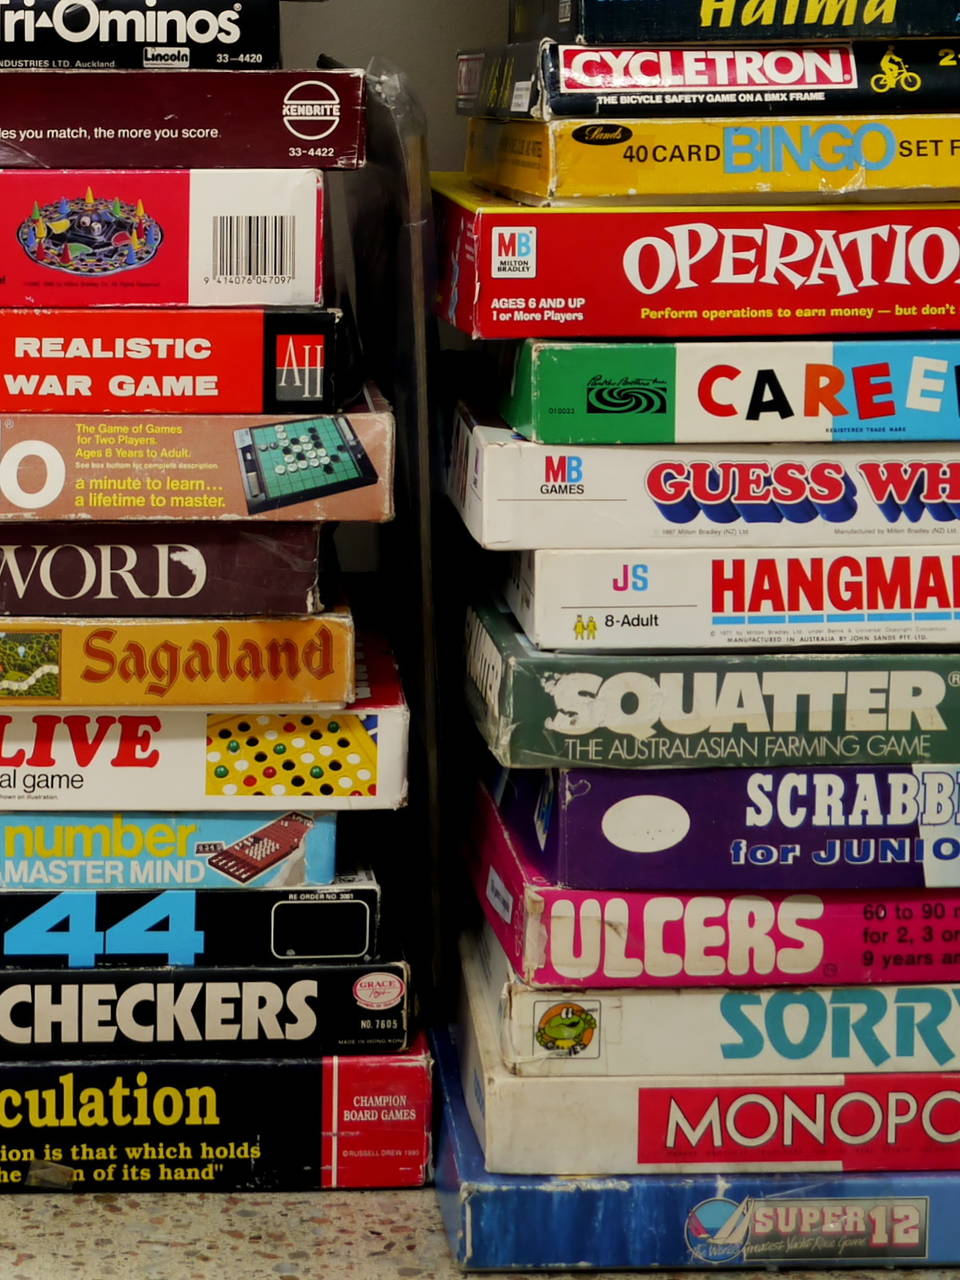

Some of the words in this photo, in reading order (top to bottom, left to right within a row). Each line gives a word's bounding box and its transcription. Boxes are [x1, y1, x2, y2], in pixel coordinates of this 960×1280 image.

[143, 48, 189, 65] Lincoln
[282, 104, 340, 117] KENBRITE
[620, 95, 663, 105] BICYCLE
[764, 93, 787, 102] BMX
[46, 127, 91, 140] match,
[653, 144, 721, 162] CARD
[722, 122, 896, 174] BINGO
[898, 140, 943, 157] SET
[498, 232, 532, 257] MB
[622, 223, 960, 295] OPERATIO
[491, 298, 526, 309] AGES
[640, 307, 698, 320] Perform
[702, 307, 774, 320] operations
[543, 311, 584, 322] Players
[14, 337, 212, 360] REALISTIC
[3, 374, 92, 396] WAR
[108, 375, 219, 397] GAME
[697, 356, 960, 422] CAREE
[94, 424, 130, 434] Game
[545, 455, 583, 484] MB
[540, 484, 585, 496] GAMES
[645, 460, 851, 514] GUESS
[89, 494, 145, 507] lifetime
[169, 495, 225, 507] master.
[612, 563, 649, 592] JS
[712, 554, 960, 613] HANGMA
[604, 613, 659, 628] 8-Adult
[80, 627, 335, 697] Sagaland
[543, 670, 948, 739] SQUATTER
[608, 736, 759, 760] AUSTRALASIAN
[764, 735, 859, 758] FARMING
[867, 734, 931, 757] GAME
[22, 772, 84, 794] game
[746, 772, 960, 828] SCRABB
[4, 813, 197, 858] number
[731, 838, 800, 866] for
[4, 860, 128, 883] MASTER
[130, 860, 206, 883] MIND
[3, 890, 205, 967] 44
[550, 894, 825, 979] ULCERS
[882, 952, 933, 969] years
[375, 1019, 397, 1029] 7605
[720, 987, 960, 1067] SORR
[353, 1095, 407, 1108] CHAMPION
[343, 1109, 378, 1122] BOARD
[381, 1109, 416, 1121] GAMES
[755, 1206, 865, 1234] SUPER
[868, 1205, 921, 1248] 12
